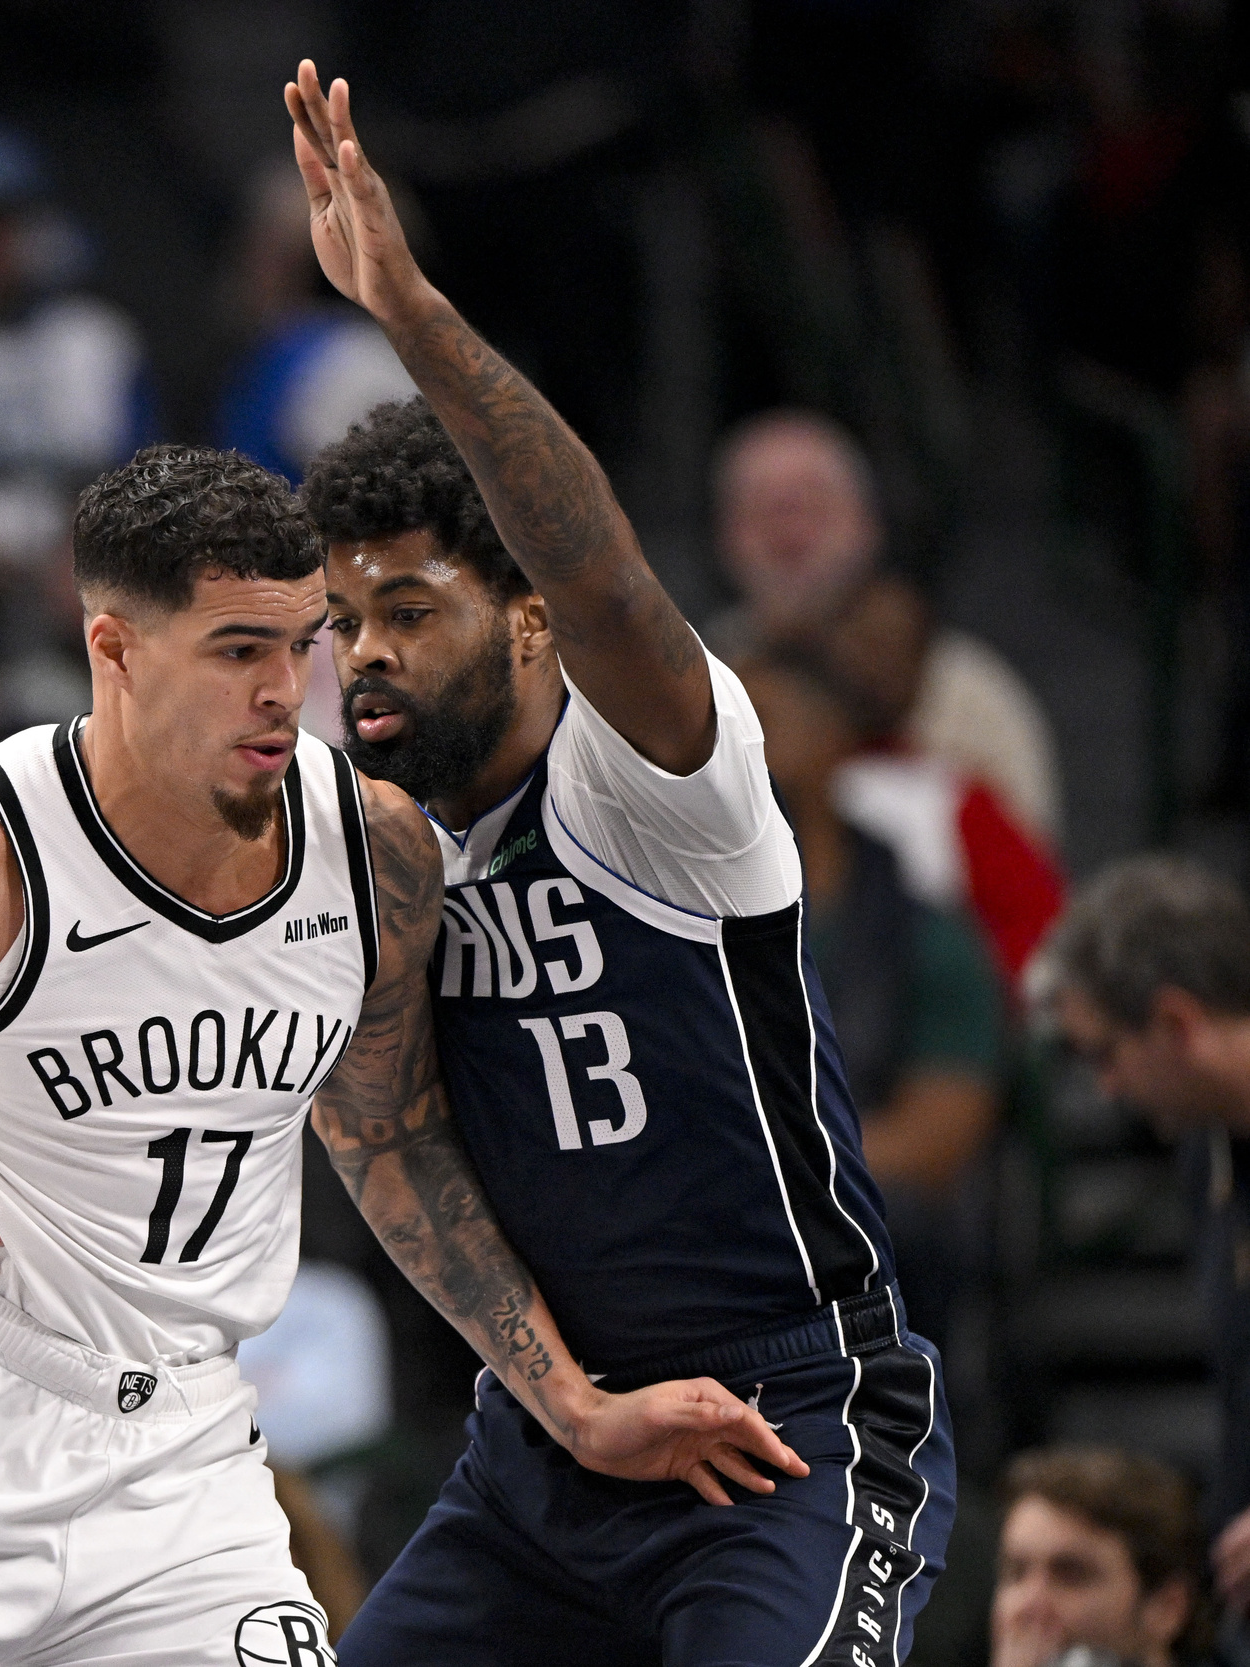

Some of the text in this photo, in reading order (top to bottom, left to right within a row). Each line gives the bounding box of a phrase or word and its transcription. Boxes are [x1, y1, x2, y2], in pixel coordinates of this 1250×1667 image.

[490, 829, 537, 876] chime
[284, 911, 348, 944] All In Won
[440, 877, 604, 999] AVS
[517, 1011, 648, 1150] 13
[139, 1127, 254, 1264] 17
[120, 1374, 155, 1395] NETS
